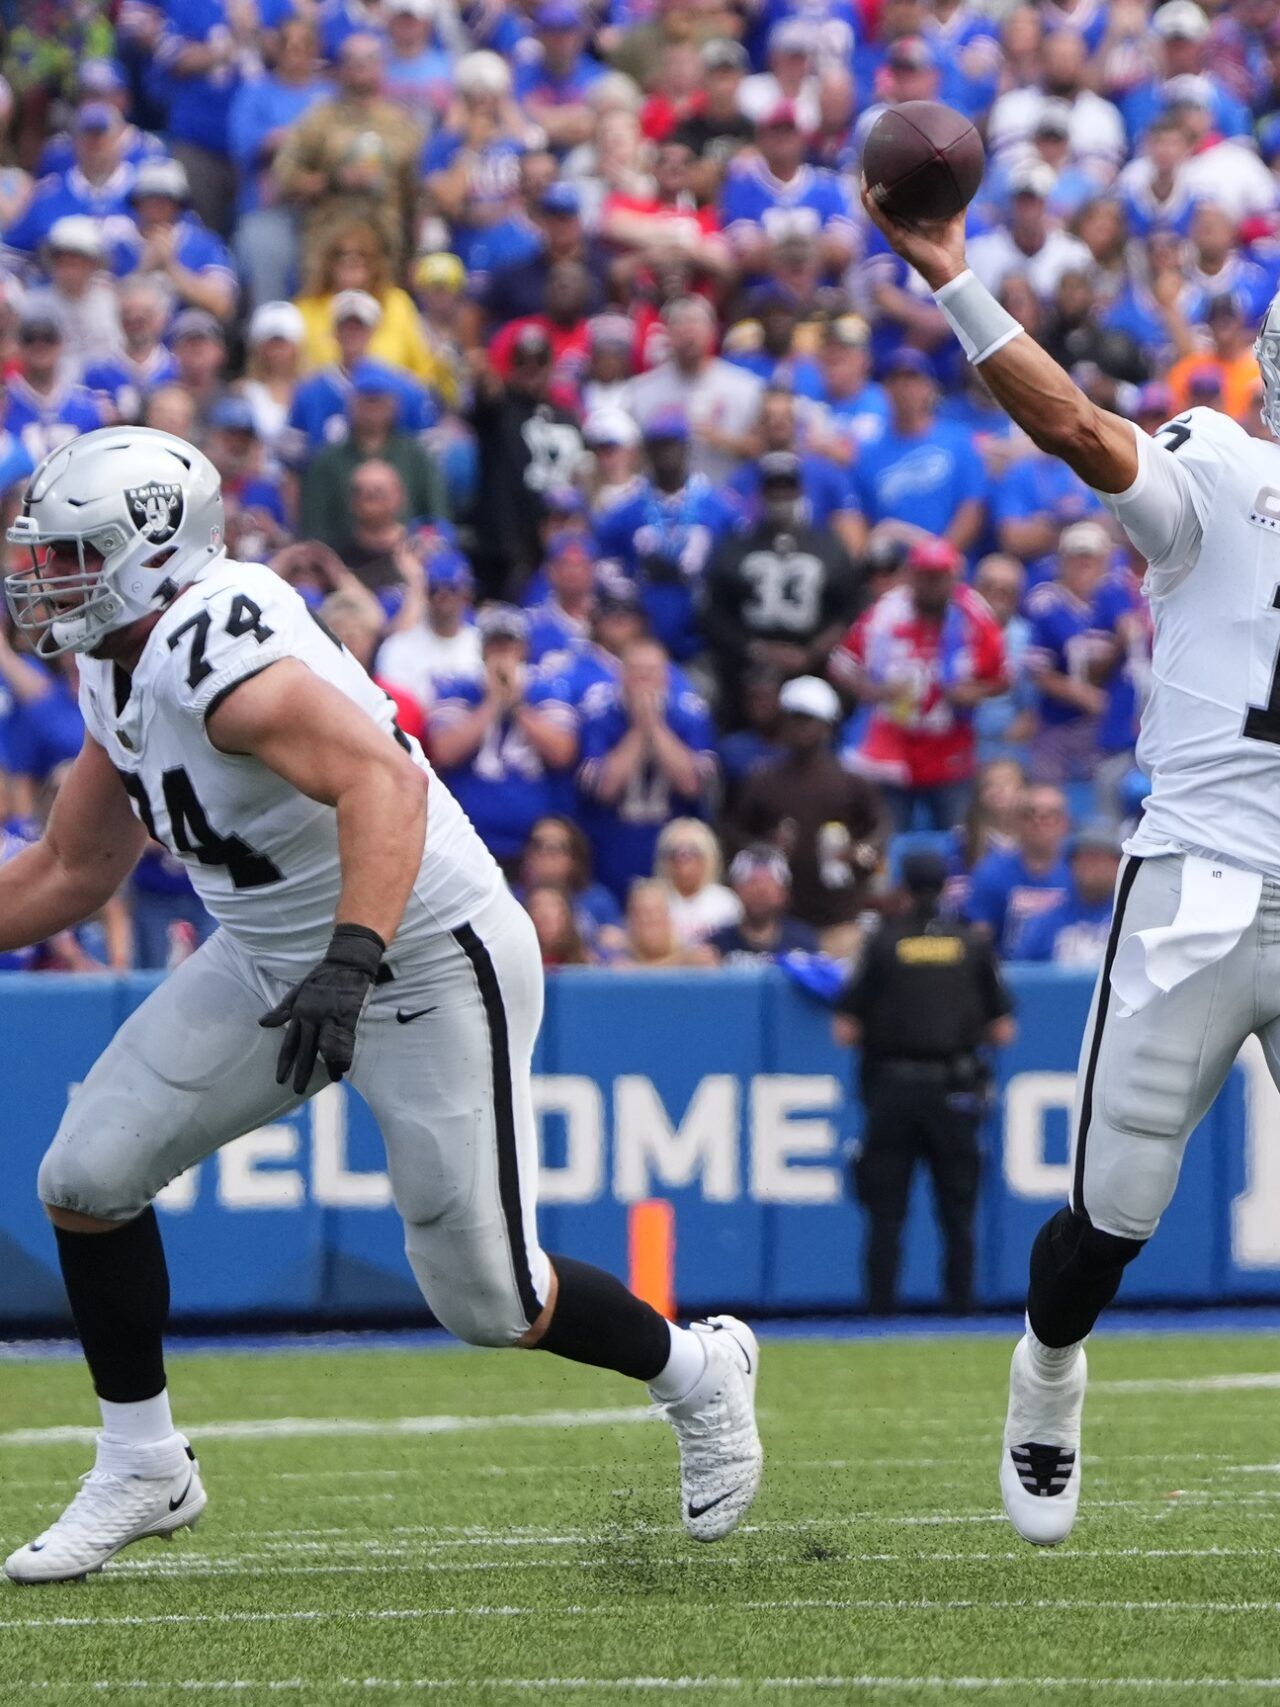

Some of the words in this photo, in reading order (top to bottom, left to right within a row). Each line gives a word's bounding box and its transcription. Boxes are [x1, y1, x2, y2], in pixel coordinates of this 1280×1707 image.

[166, 593, 275, 690] 74
[118, 764, 287, 890] 74
[1212, 870, 1222, 879] 10
[68, 1073, 842, 1212] ELOME
